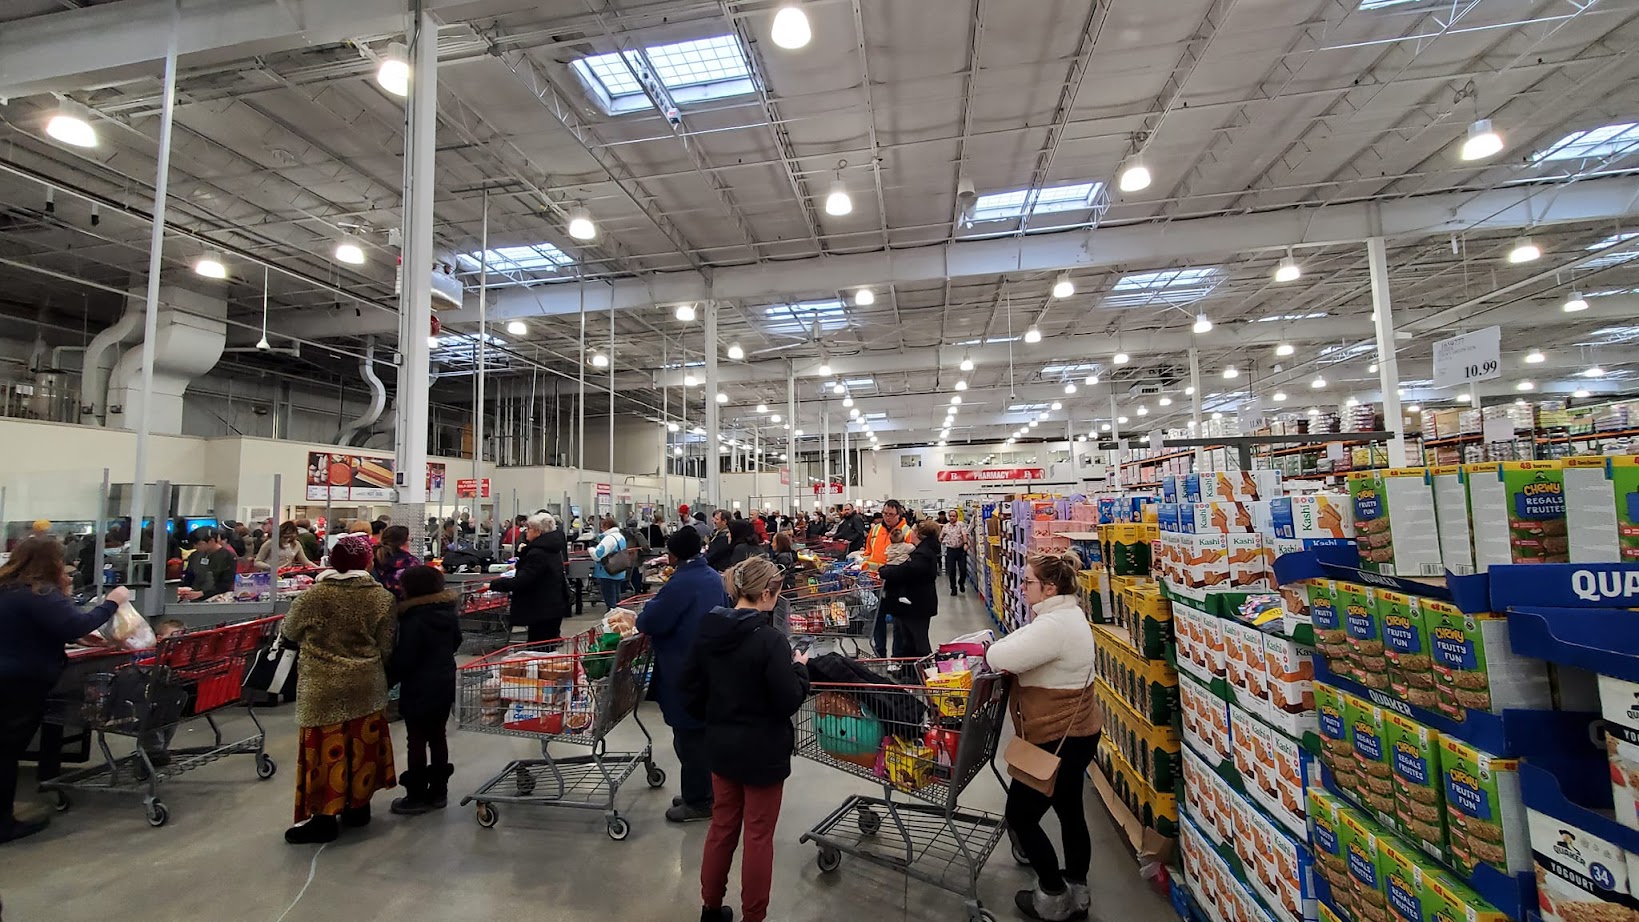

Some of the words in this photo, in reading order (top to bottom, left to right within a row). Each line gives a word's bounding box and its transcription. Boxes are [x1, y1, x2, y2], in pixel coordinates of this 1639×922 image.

[1464, 360, 1497, 378] 10.99
[974, 471, 1010, 480] PHARMACY
[818, 486, 838, 494] EXMS
[1205, 479, 1213, 498] Kashi
[1358, 500, 1377, 508] FRUITY
[1526, 497, 1563, 505] REGALS
[1526, 505, 1566, 514] FRUITES
[1300, 504, 1312, 531] Kashi
[1279, 544, 1297, 554] Kashi
[1571, 570, 1639, 601] QUA
[1315, 609, 1332, 617] FRUITY
[1431, 603, 1440, 611] 48
[1349, 617, 1369, 626] FRUITY
[1224, 624, 1237, 637] Kashi
[1243, 630, 1257, 645] Kashi
[1354, 626, 1366, 634] FUN
[1387, 628, 1411, 638] FRUITY
[1266, 639, 1282, 653] Kashi
[1392, 638, 1408, 647] FUN
[1437, 641, 1466, 654] FRUITY
[1444, 653, 1462, 663] FUN
[1368, 689, 1415, 718] QUAKER
[1251, 722, 1266, 739] Kashi
[1275, 737, 1293, 755] Kashi
[1356, 733, 1377, 747] REGALS
[1448, 743, 1456, 752] 48
[1357, 741, 1378, 756] FRUITES
[1398, 753, 1421, 769] REGALS
[1398, 763, 1424, 780] FRUITES
[1452, 783, 1480, 802] FRUITY
[1458, 796, 1477, 811] FUN
[1274, 833, 1292, 856] Kashi
[1553, 845, 1586, 867] QUAKER
[1550, 861, 1594, 892] YOGOURT
[1593, 866, 1609, 886] 34
[1392, 886, 1416, 909] REGALS
[1392, 896, 1418, 920] FRUITES
